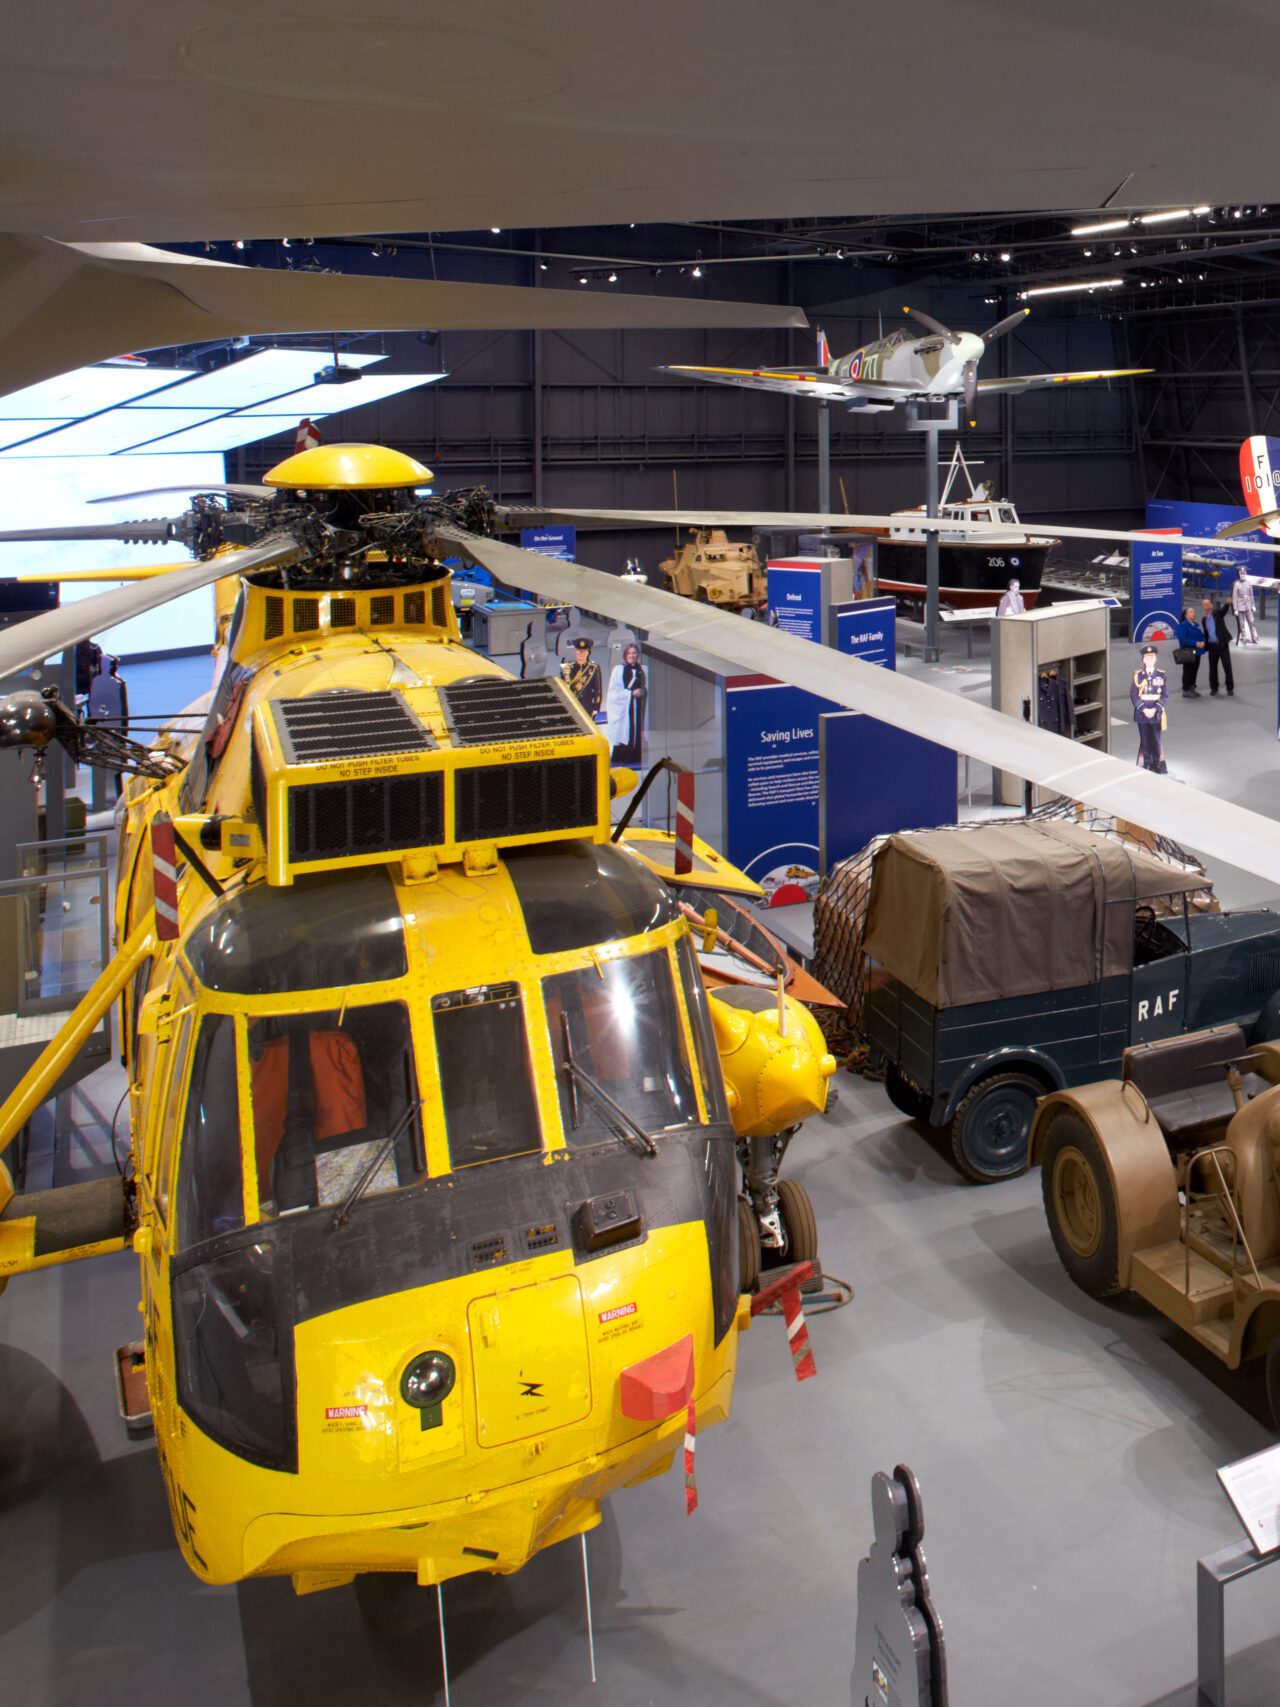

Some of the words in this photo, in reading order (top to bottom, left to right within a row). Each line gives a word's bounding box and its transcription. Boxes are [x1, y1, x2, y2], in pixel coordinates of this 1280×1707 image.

[1257, 455, 1264, 469] F
[987, 556, 1005, 568] 206
[850, 634, 860, 644] The
[860, 633, 868, 643] RAF
[868, 630, 884, 642] Family
[760, 730, 790, 743] Saving
[792, 728, 814, 740] Lives
[509, 744, 528, 752] PUSH
[514, 751, 532, 760] STEP
[534, 748, 556, 757] INSIDE
[330, 762, 344, 770] NOT
[371, 758, 394, 766] FILTER
[397, 754, 420, 762] TUBES
[340, 770, 350, 778] NO
[354, 768, 372, 776] STEP
[375, 765, 398, 774] INSIDE
[1138, 989, 1179, 1022] RAF
[601, 1303, 636, 1322] WARNING
[328, 1406, 366, 1419] WARNING
